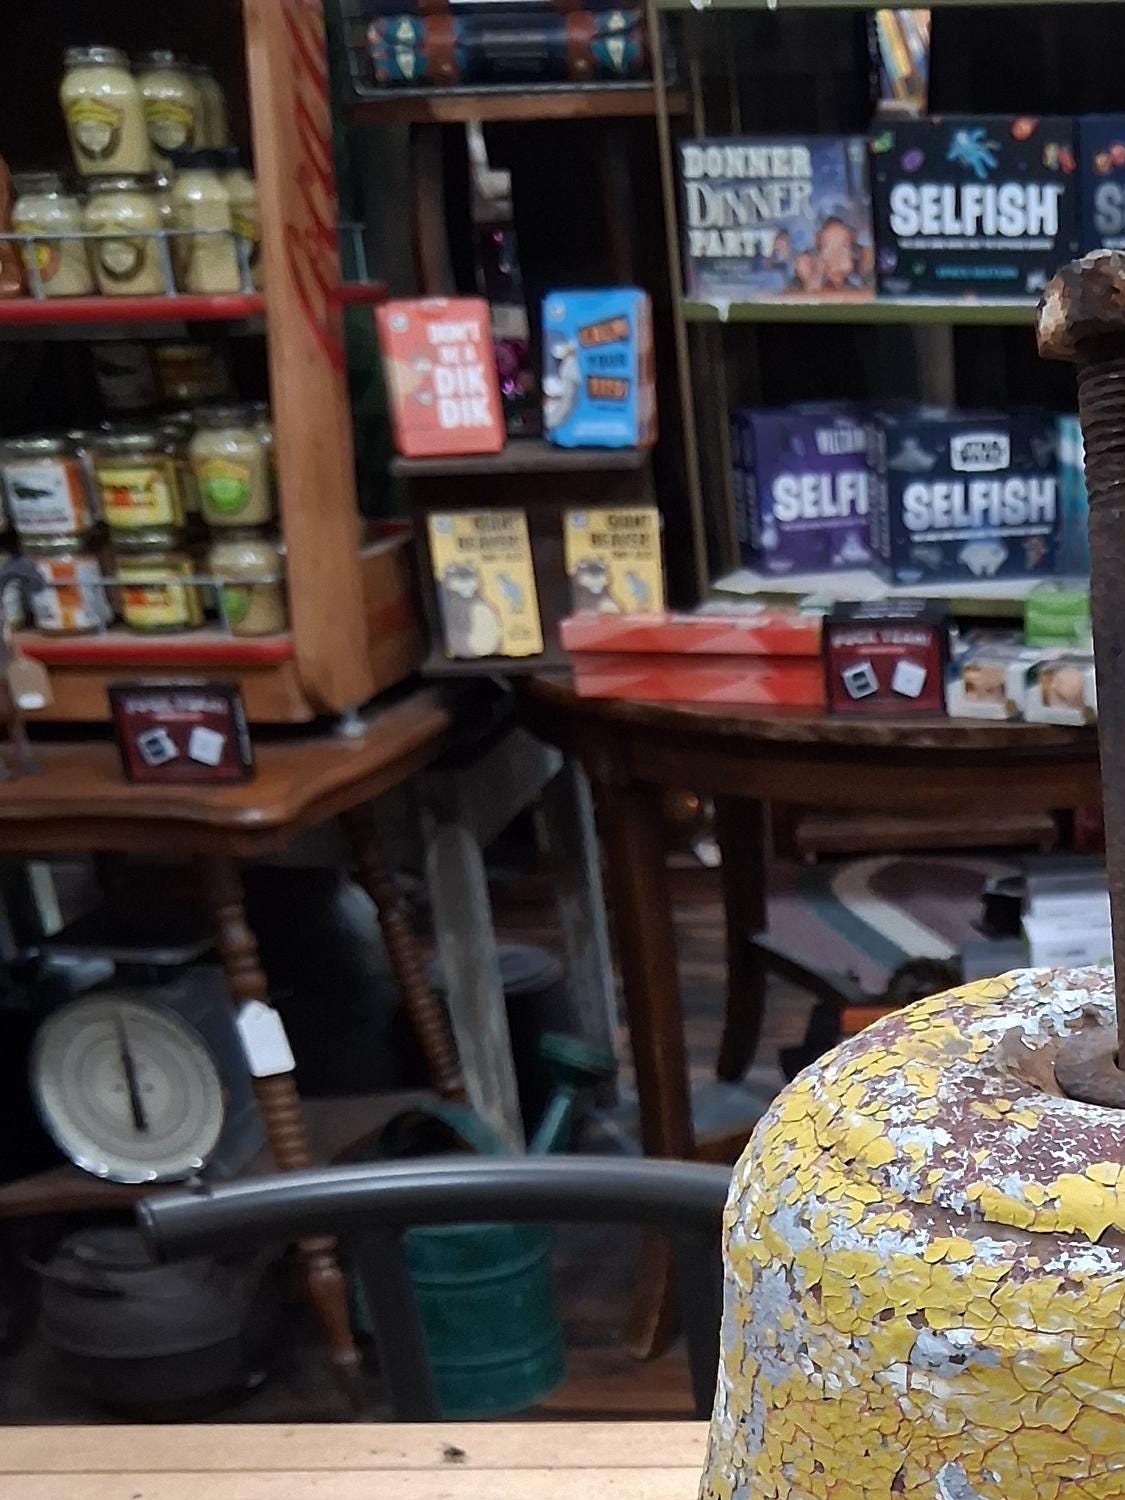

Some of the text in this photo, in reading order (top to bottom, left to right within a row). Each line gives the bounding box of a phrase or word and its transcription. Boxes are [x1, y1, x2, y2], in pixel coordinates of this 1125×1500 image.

[681, 145, 813, 179] DONNER
[686, 181, 815, 228] DINNER
[889, 183, 1062, 237] SELFISH
[688, 228, 777, 258] PARTY
[433, 363, 490, 398] DIK
[439, 397, 494, 429] DIK
[772, 472, 870, 521] SELFI
[902, 478, 1057, 532] SELFISH
